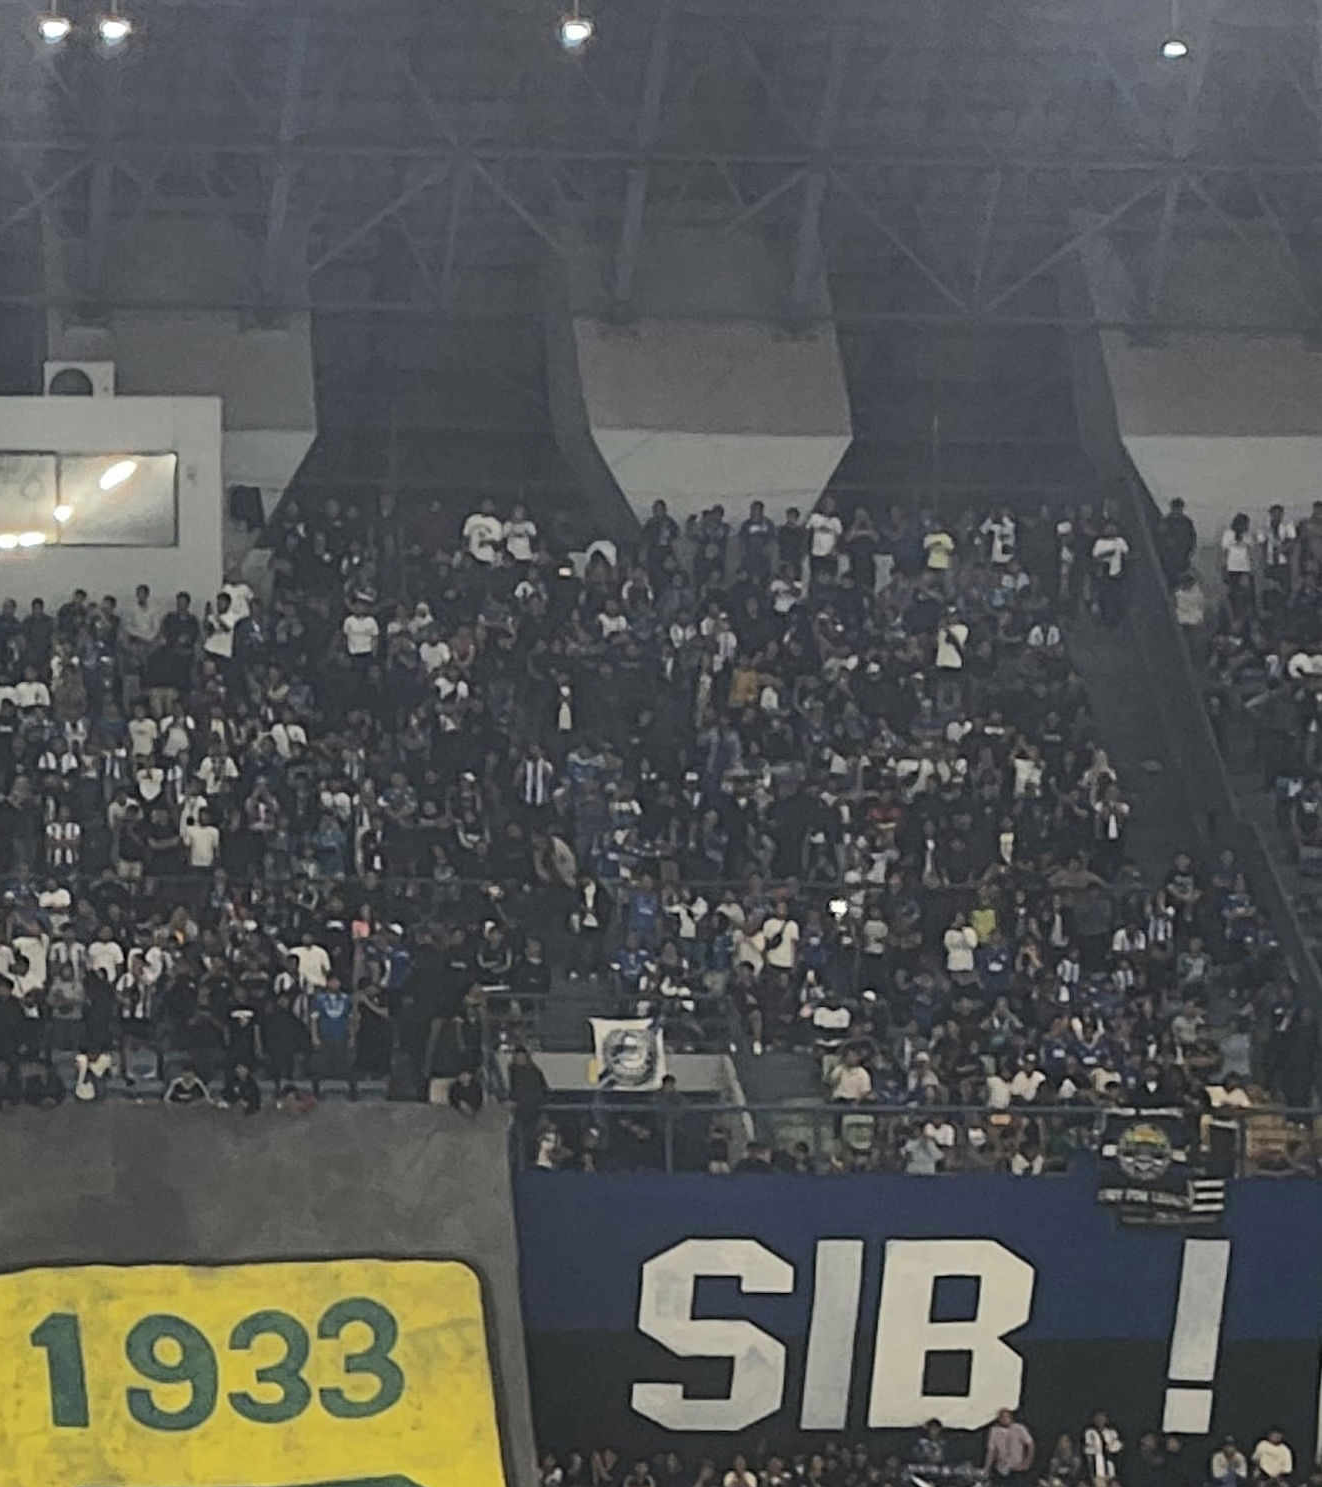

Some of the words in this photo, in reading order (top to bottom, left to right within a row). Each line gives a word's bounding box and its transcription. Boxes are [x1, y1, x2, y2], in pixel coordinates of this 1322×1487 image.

[30, 1296, 405, 1431] 1933
[631, 1238, 1035, 1432] SIB
[1162, 1238, 1231, 1434] !
